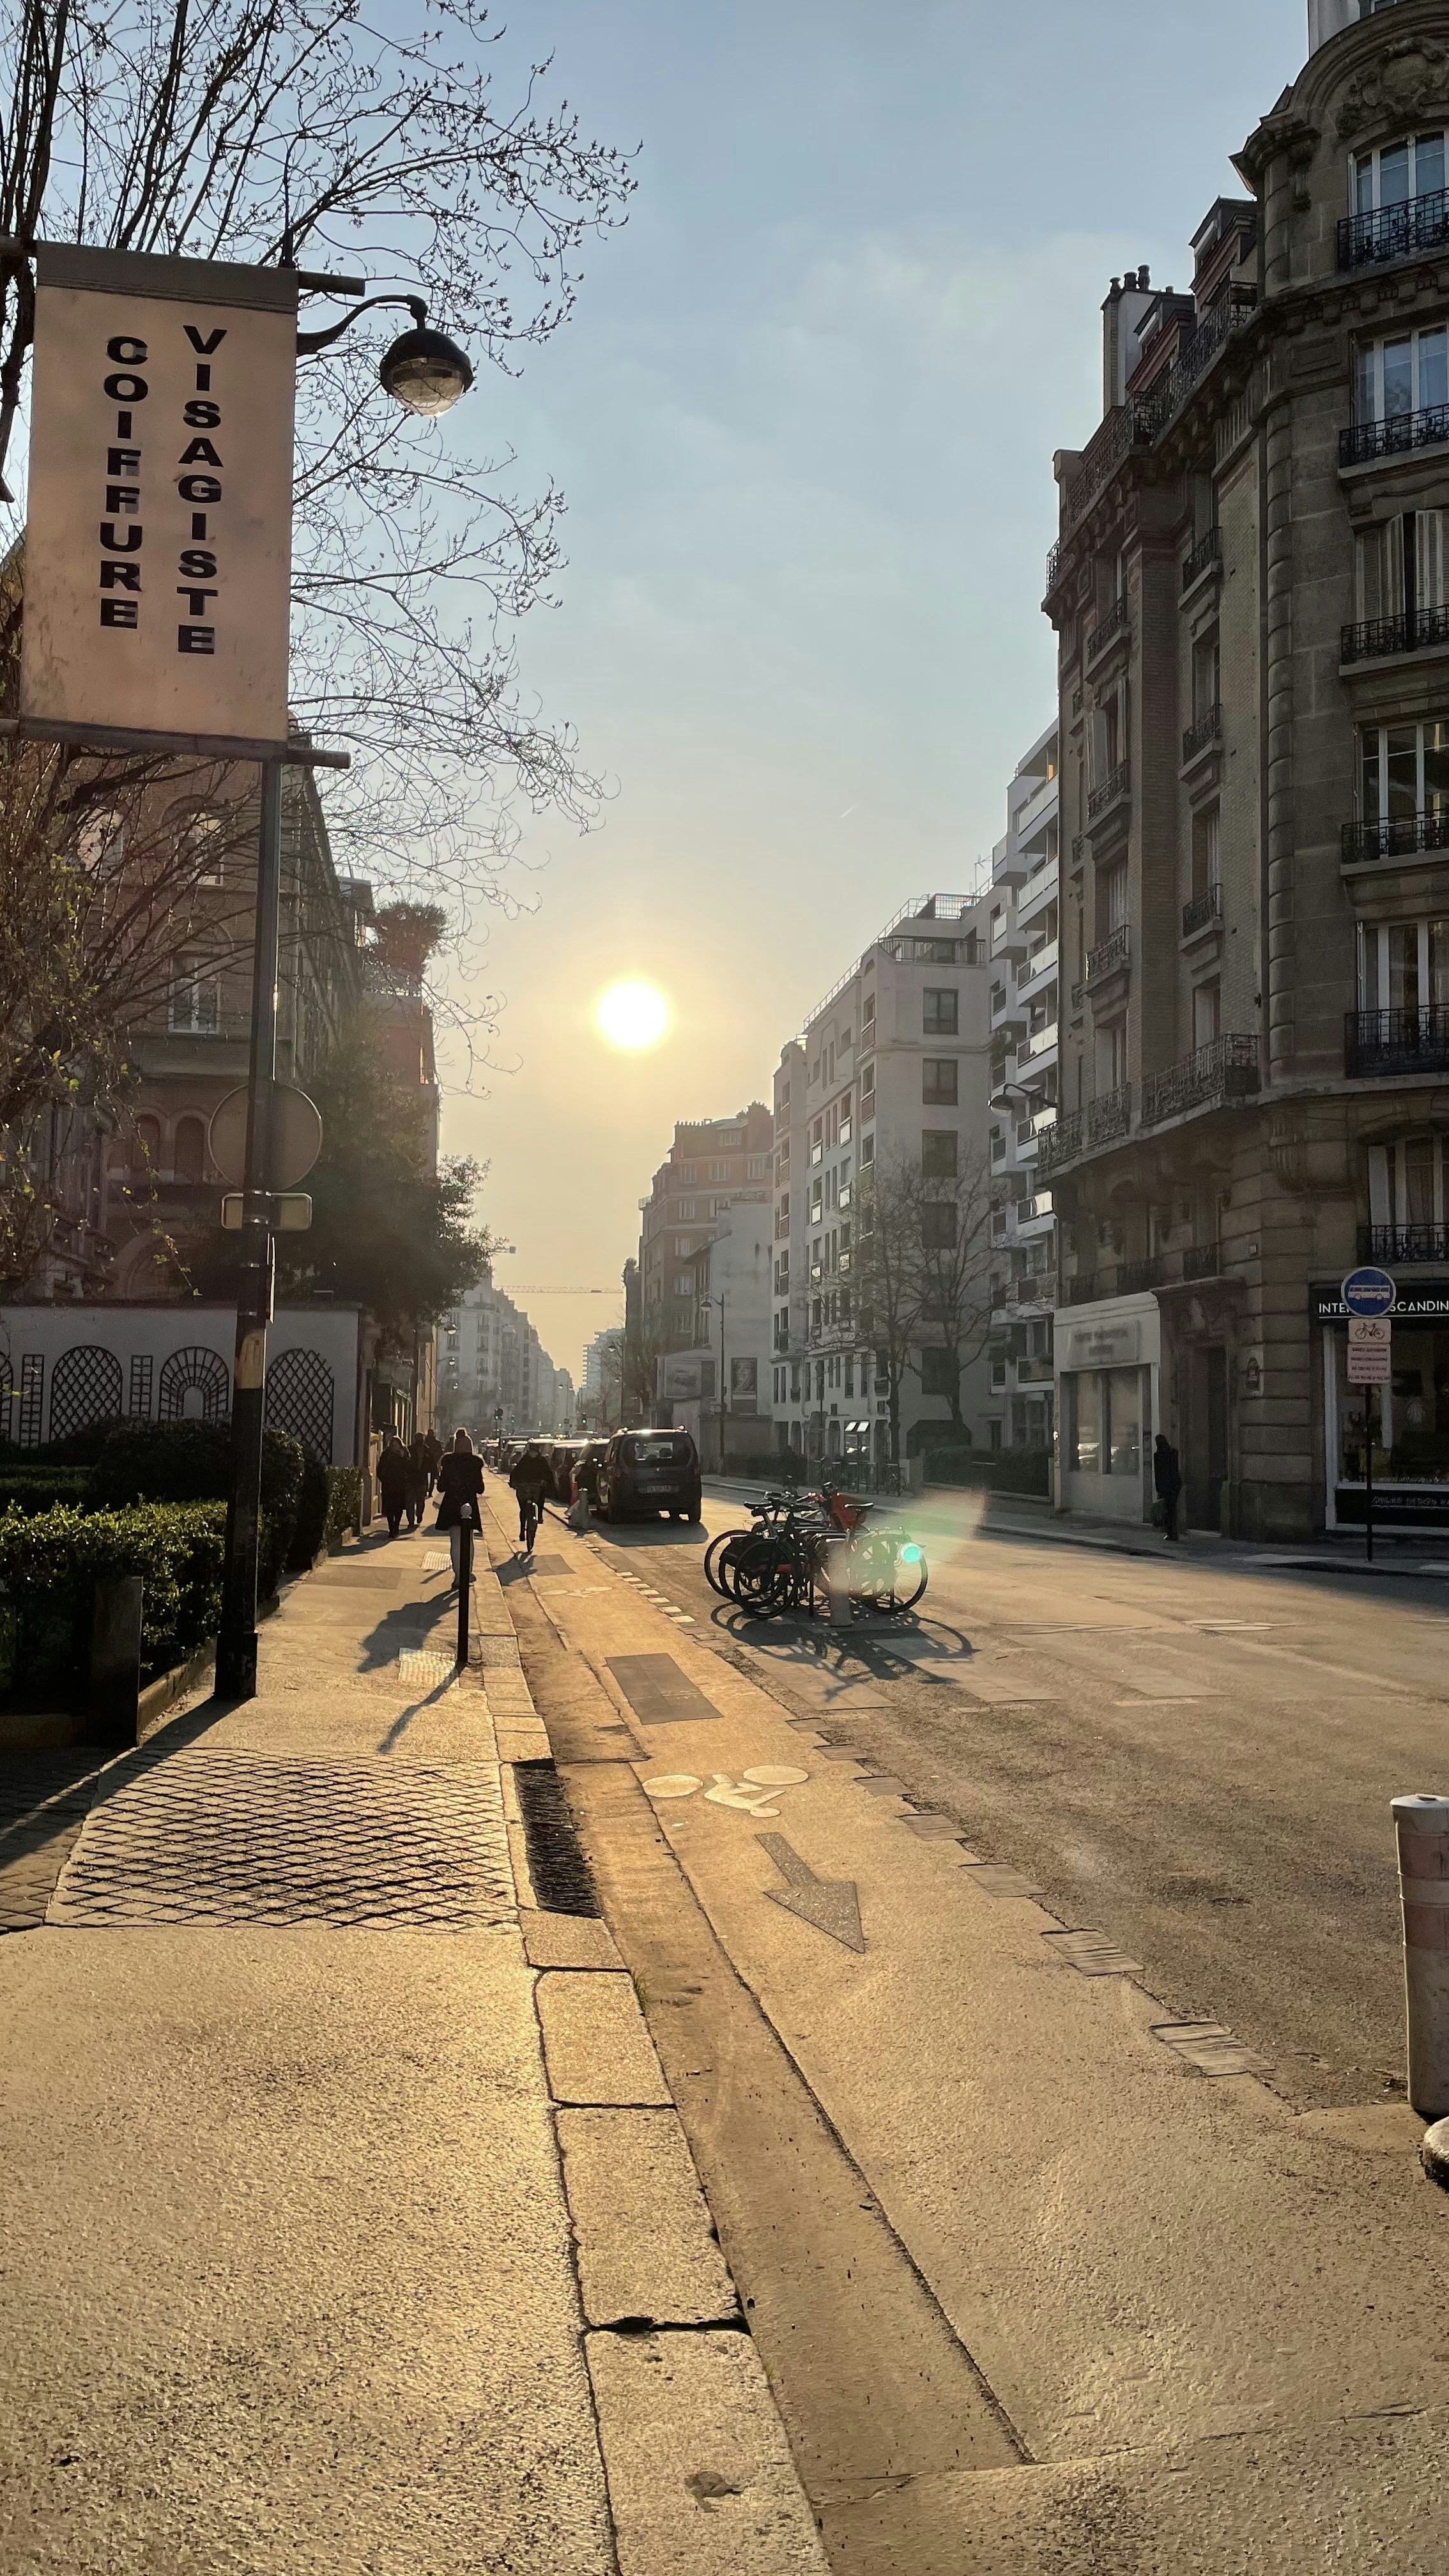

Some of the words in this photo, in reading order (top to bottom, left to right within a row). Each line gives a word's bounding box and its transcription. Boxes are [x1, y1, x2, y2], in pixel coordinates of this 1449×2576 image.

[100, 335, 148, 629] COIFFURE
[177, 325, 227, 655] VISAGISTE
[1318, 1302, 1349, 1314] INTE
